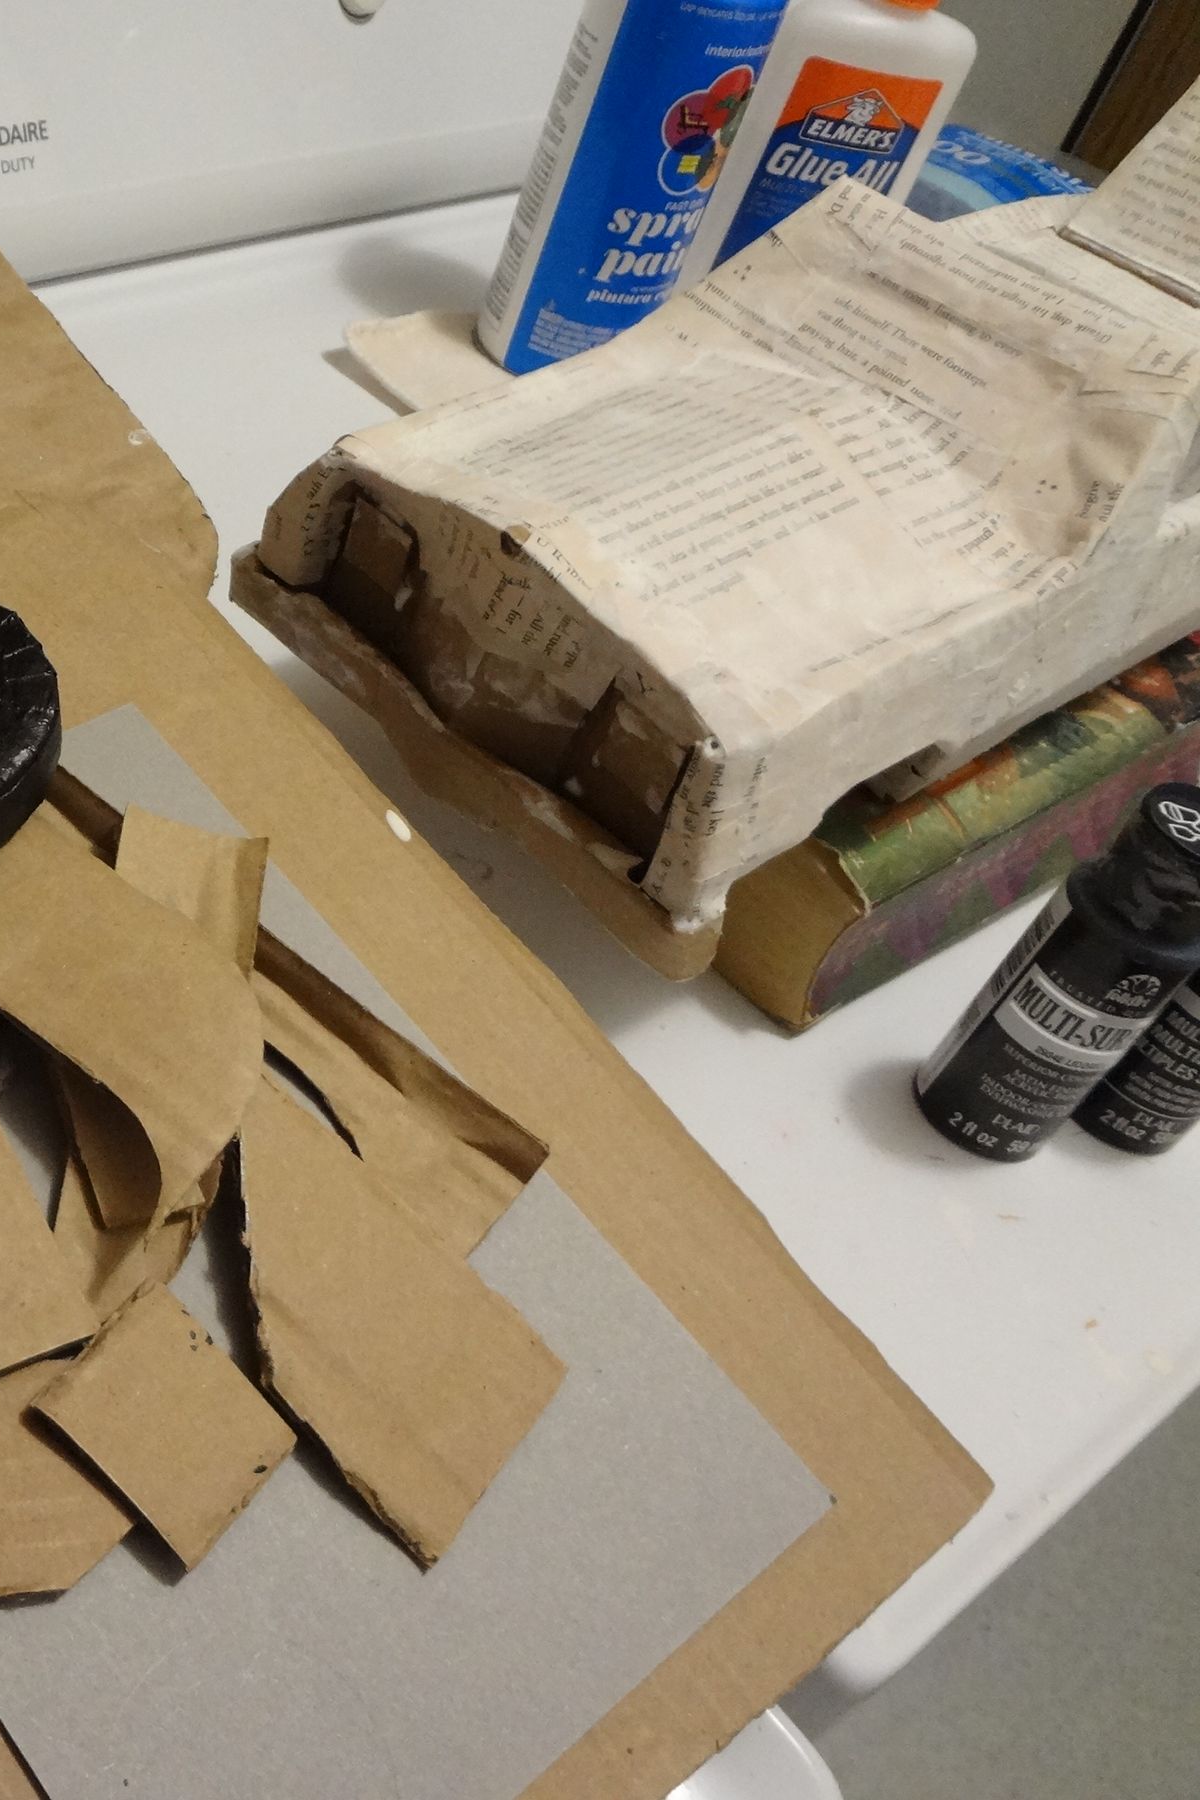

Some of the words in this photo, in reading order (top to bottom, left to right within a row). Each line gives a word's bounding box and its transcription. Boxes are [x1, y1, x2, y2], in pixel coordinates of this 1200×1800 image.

[806, 118, 896, 149] ELMER'S
[1, 156, 36, 175] DUTY
[766, 142, 849, 187] Glue
[607, 207, 706, 247] spra
[593, 240, 686, 283] pai
[949, 1111, 968, 1128] 2
[1100, 1108, 1117, 1123] 2
